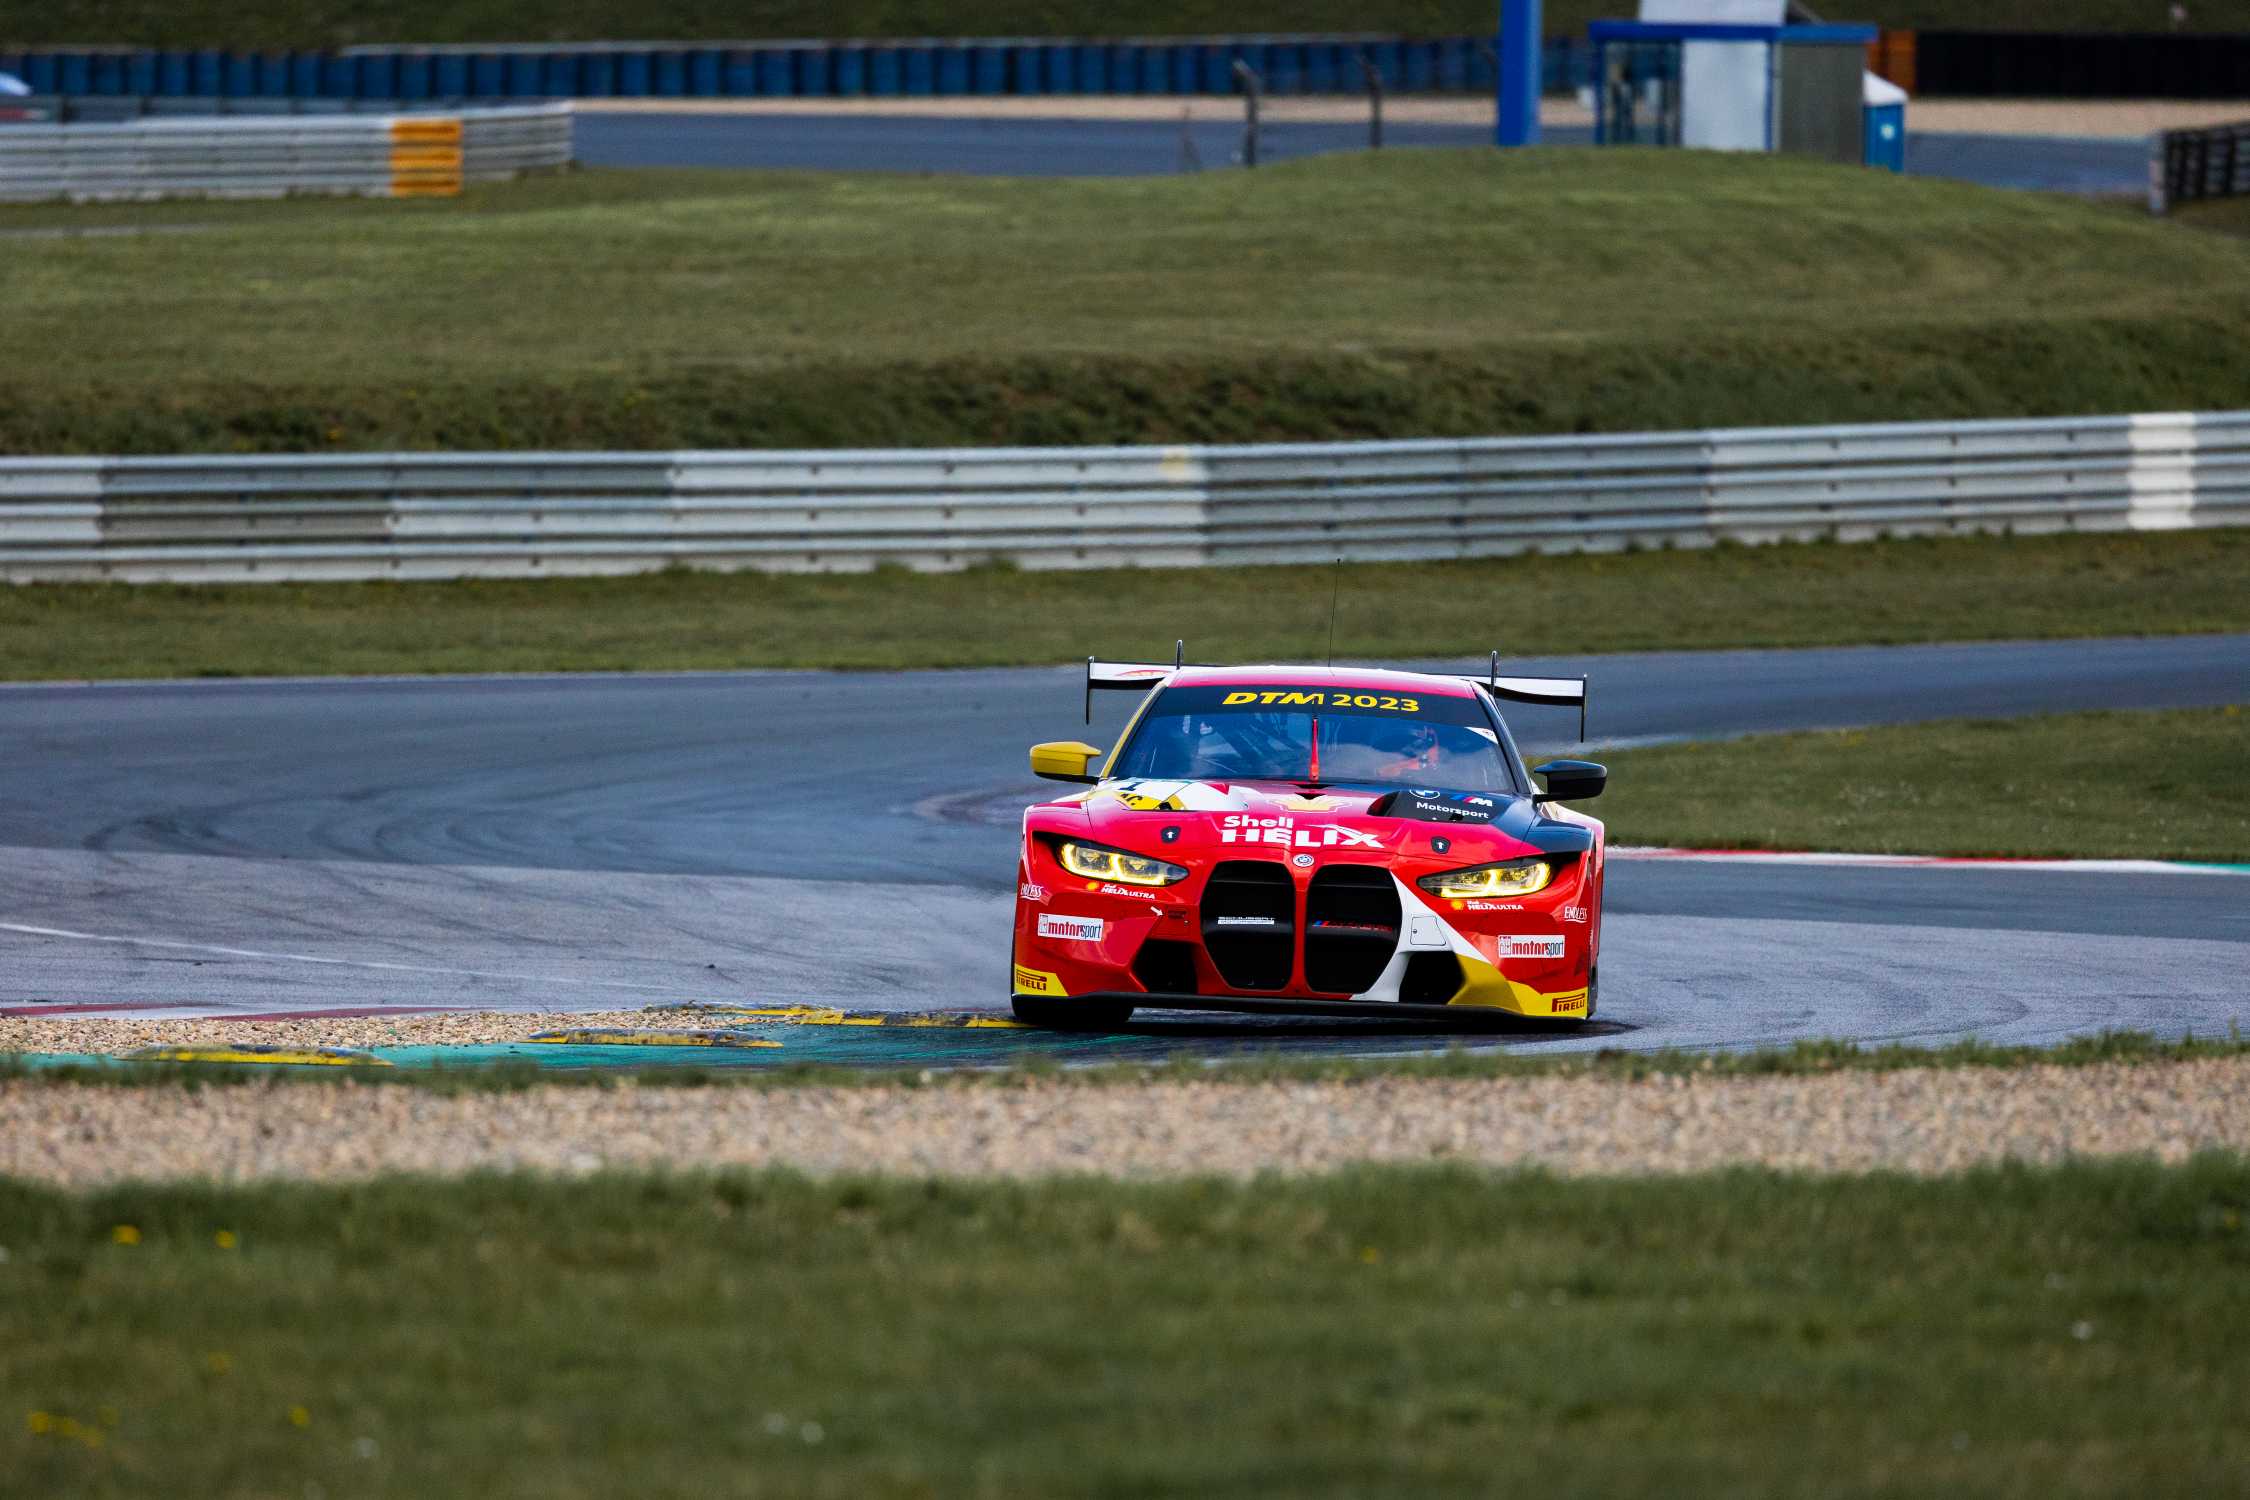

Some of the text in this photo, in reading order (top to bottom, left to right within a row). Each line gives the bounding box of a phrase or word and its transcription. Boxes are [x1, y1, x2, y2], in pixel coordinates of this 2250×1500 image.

[1222, 692, 1420, 712] DTM 2023
[1416, 801, 1489, 818] Motorsport
[1223, 815, 1294, 828] Shell
[1221, 824, 1385, 848] HELIX
[1048, 921, 1102, 939] motorsport
[1512, 940, 1564, 956] motorsport
[1552, 993, 1586, 1012] PIRELLI
